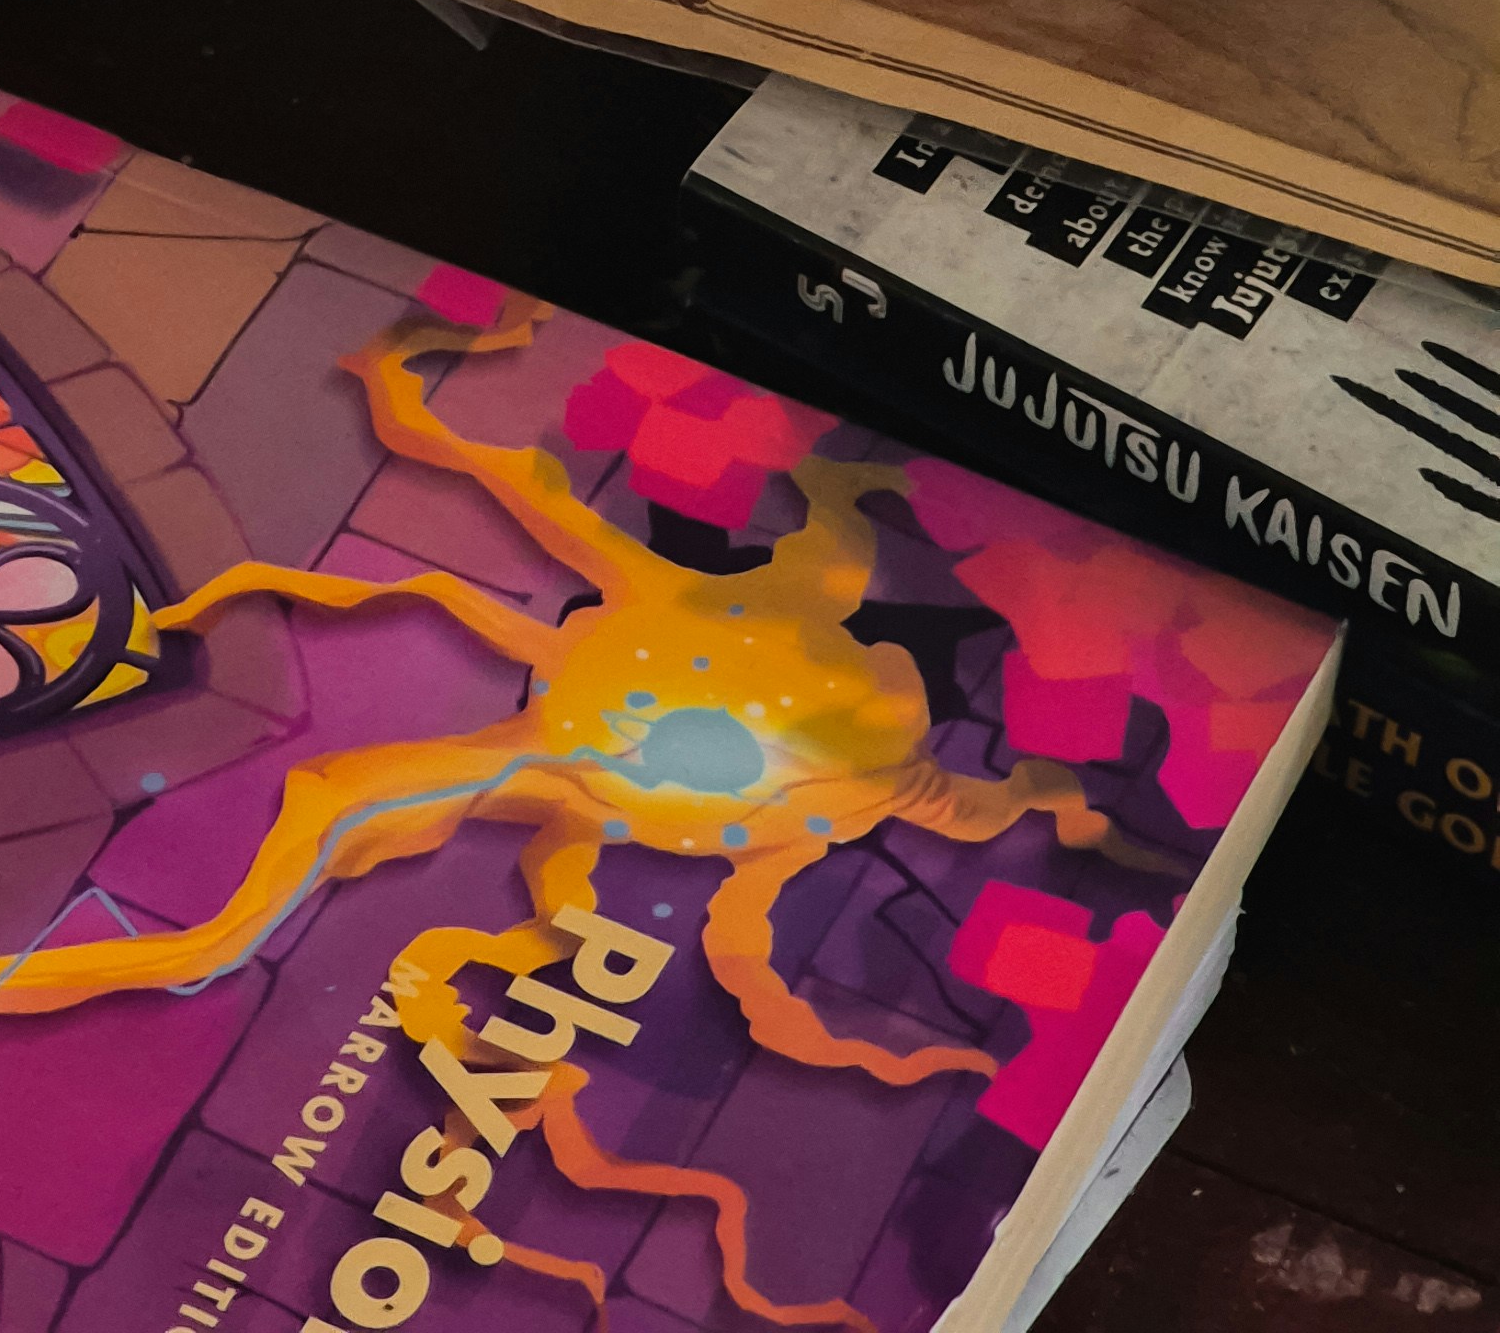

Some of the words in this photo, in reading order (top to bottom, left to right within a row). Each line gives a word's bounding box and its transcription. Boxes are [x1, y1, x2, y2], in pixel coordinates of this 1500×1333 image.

[894, 138, 940, 171] In
[1126, 216, 1173, 258] the
[1157, 234, 1230, 304] know
[941, 331, 1201, 504] JUJUTSU
[1224, 474, 1461, 639] KAISEN
[1444, 756, 1500, 814] O
[1396, 788, 1500, 874] GO
[270, 960, 431, 1188] MARROW
